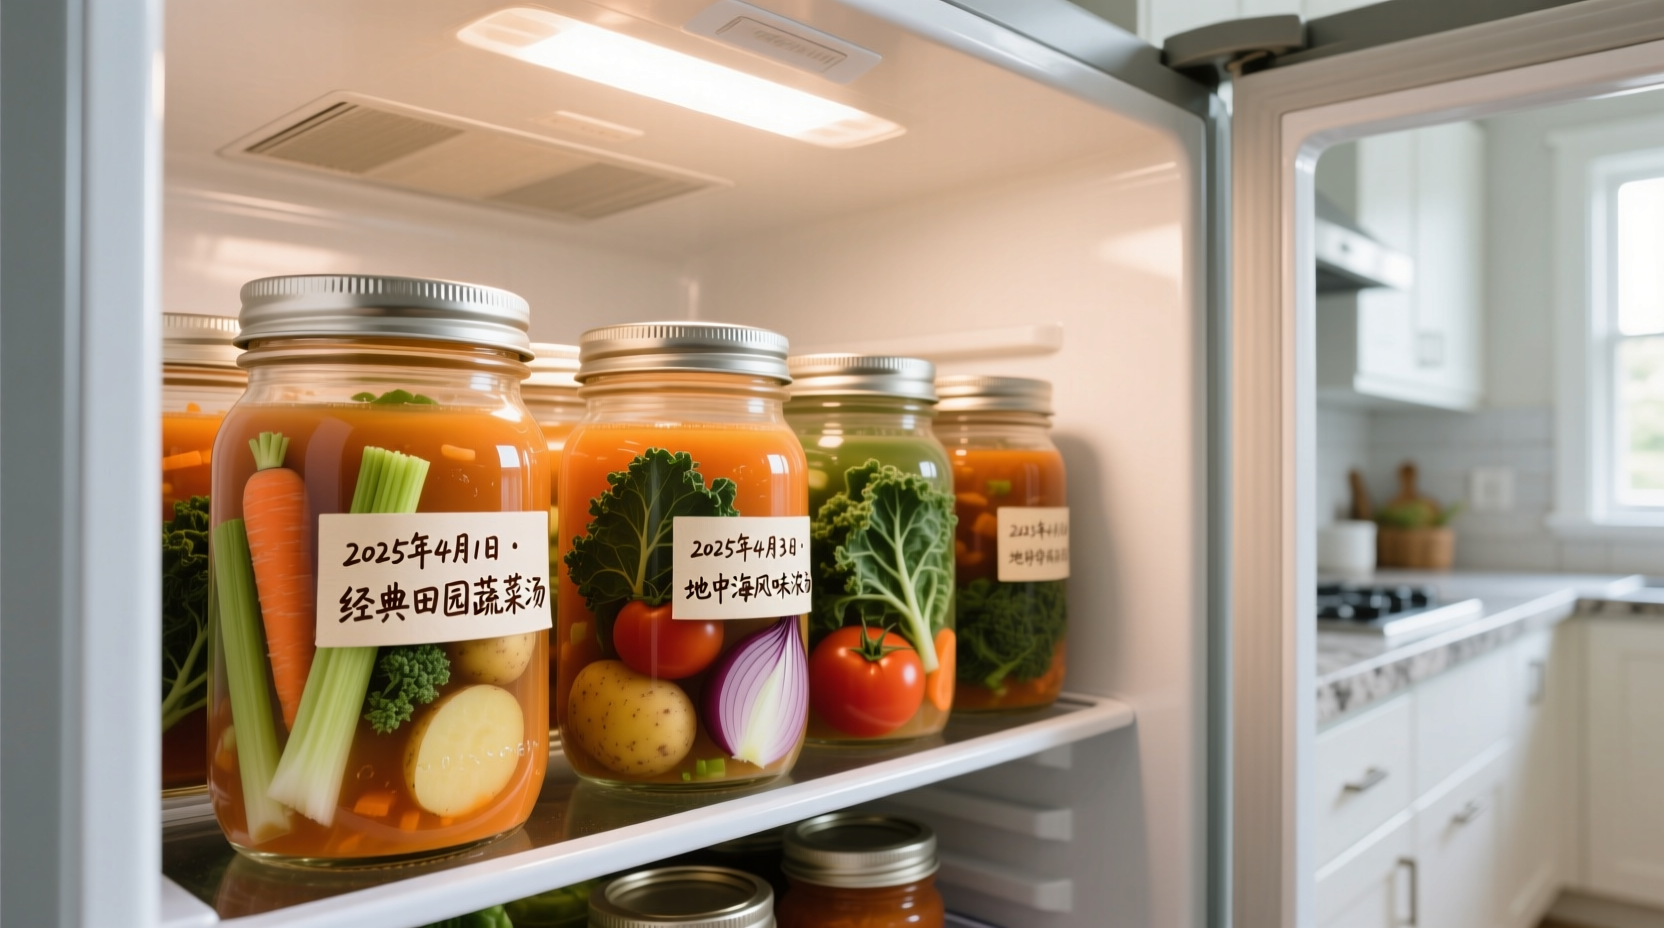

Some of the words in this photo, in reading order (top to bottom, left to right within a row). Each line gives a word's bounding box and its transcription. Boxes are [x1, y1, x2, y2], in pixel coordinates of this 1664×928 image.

[338, 572, 546, 624] 经典田园蔬菜汤
